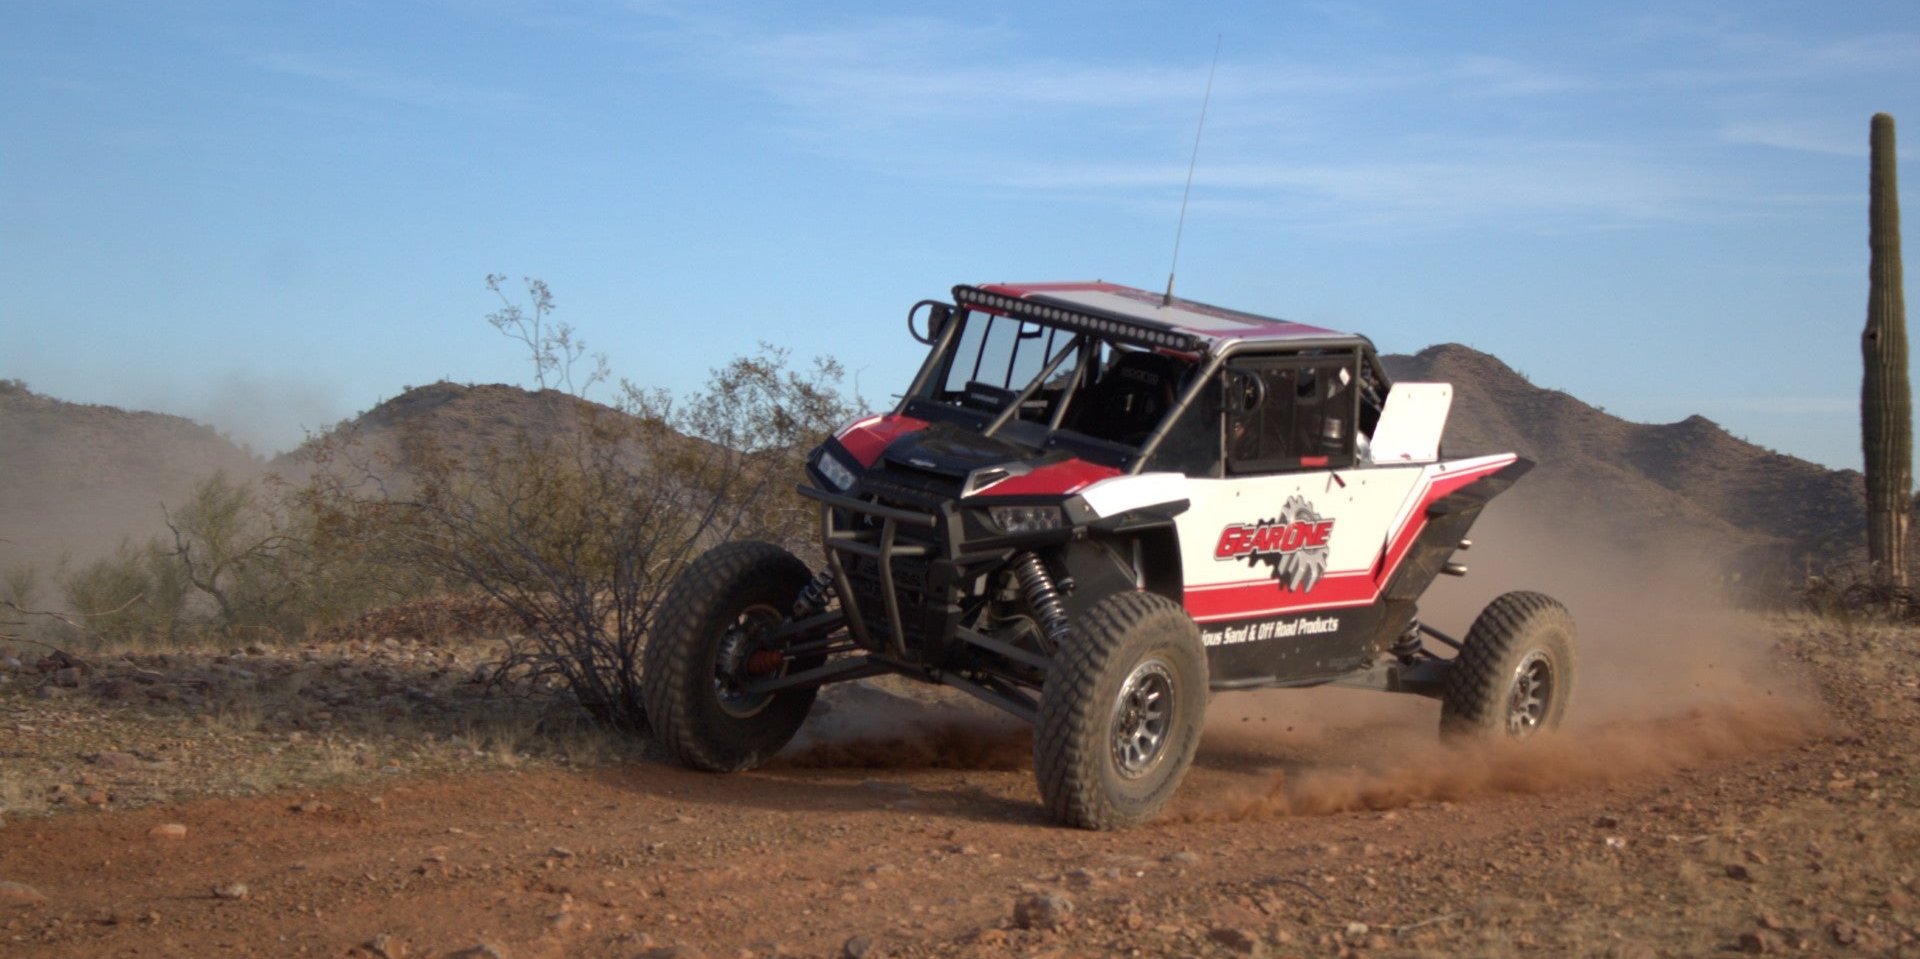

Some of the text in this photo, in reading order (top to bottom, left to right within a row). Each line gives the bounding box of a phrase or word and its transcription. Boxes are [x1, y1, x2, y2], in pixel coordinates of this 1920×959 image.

[1201, 616, 1340, 646] ious Sand & Off Road Products
